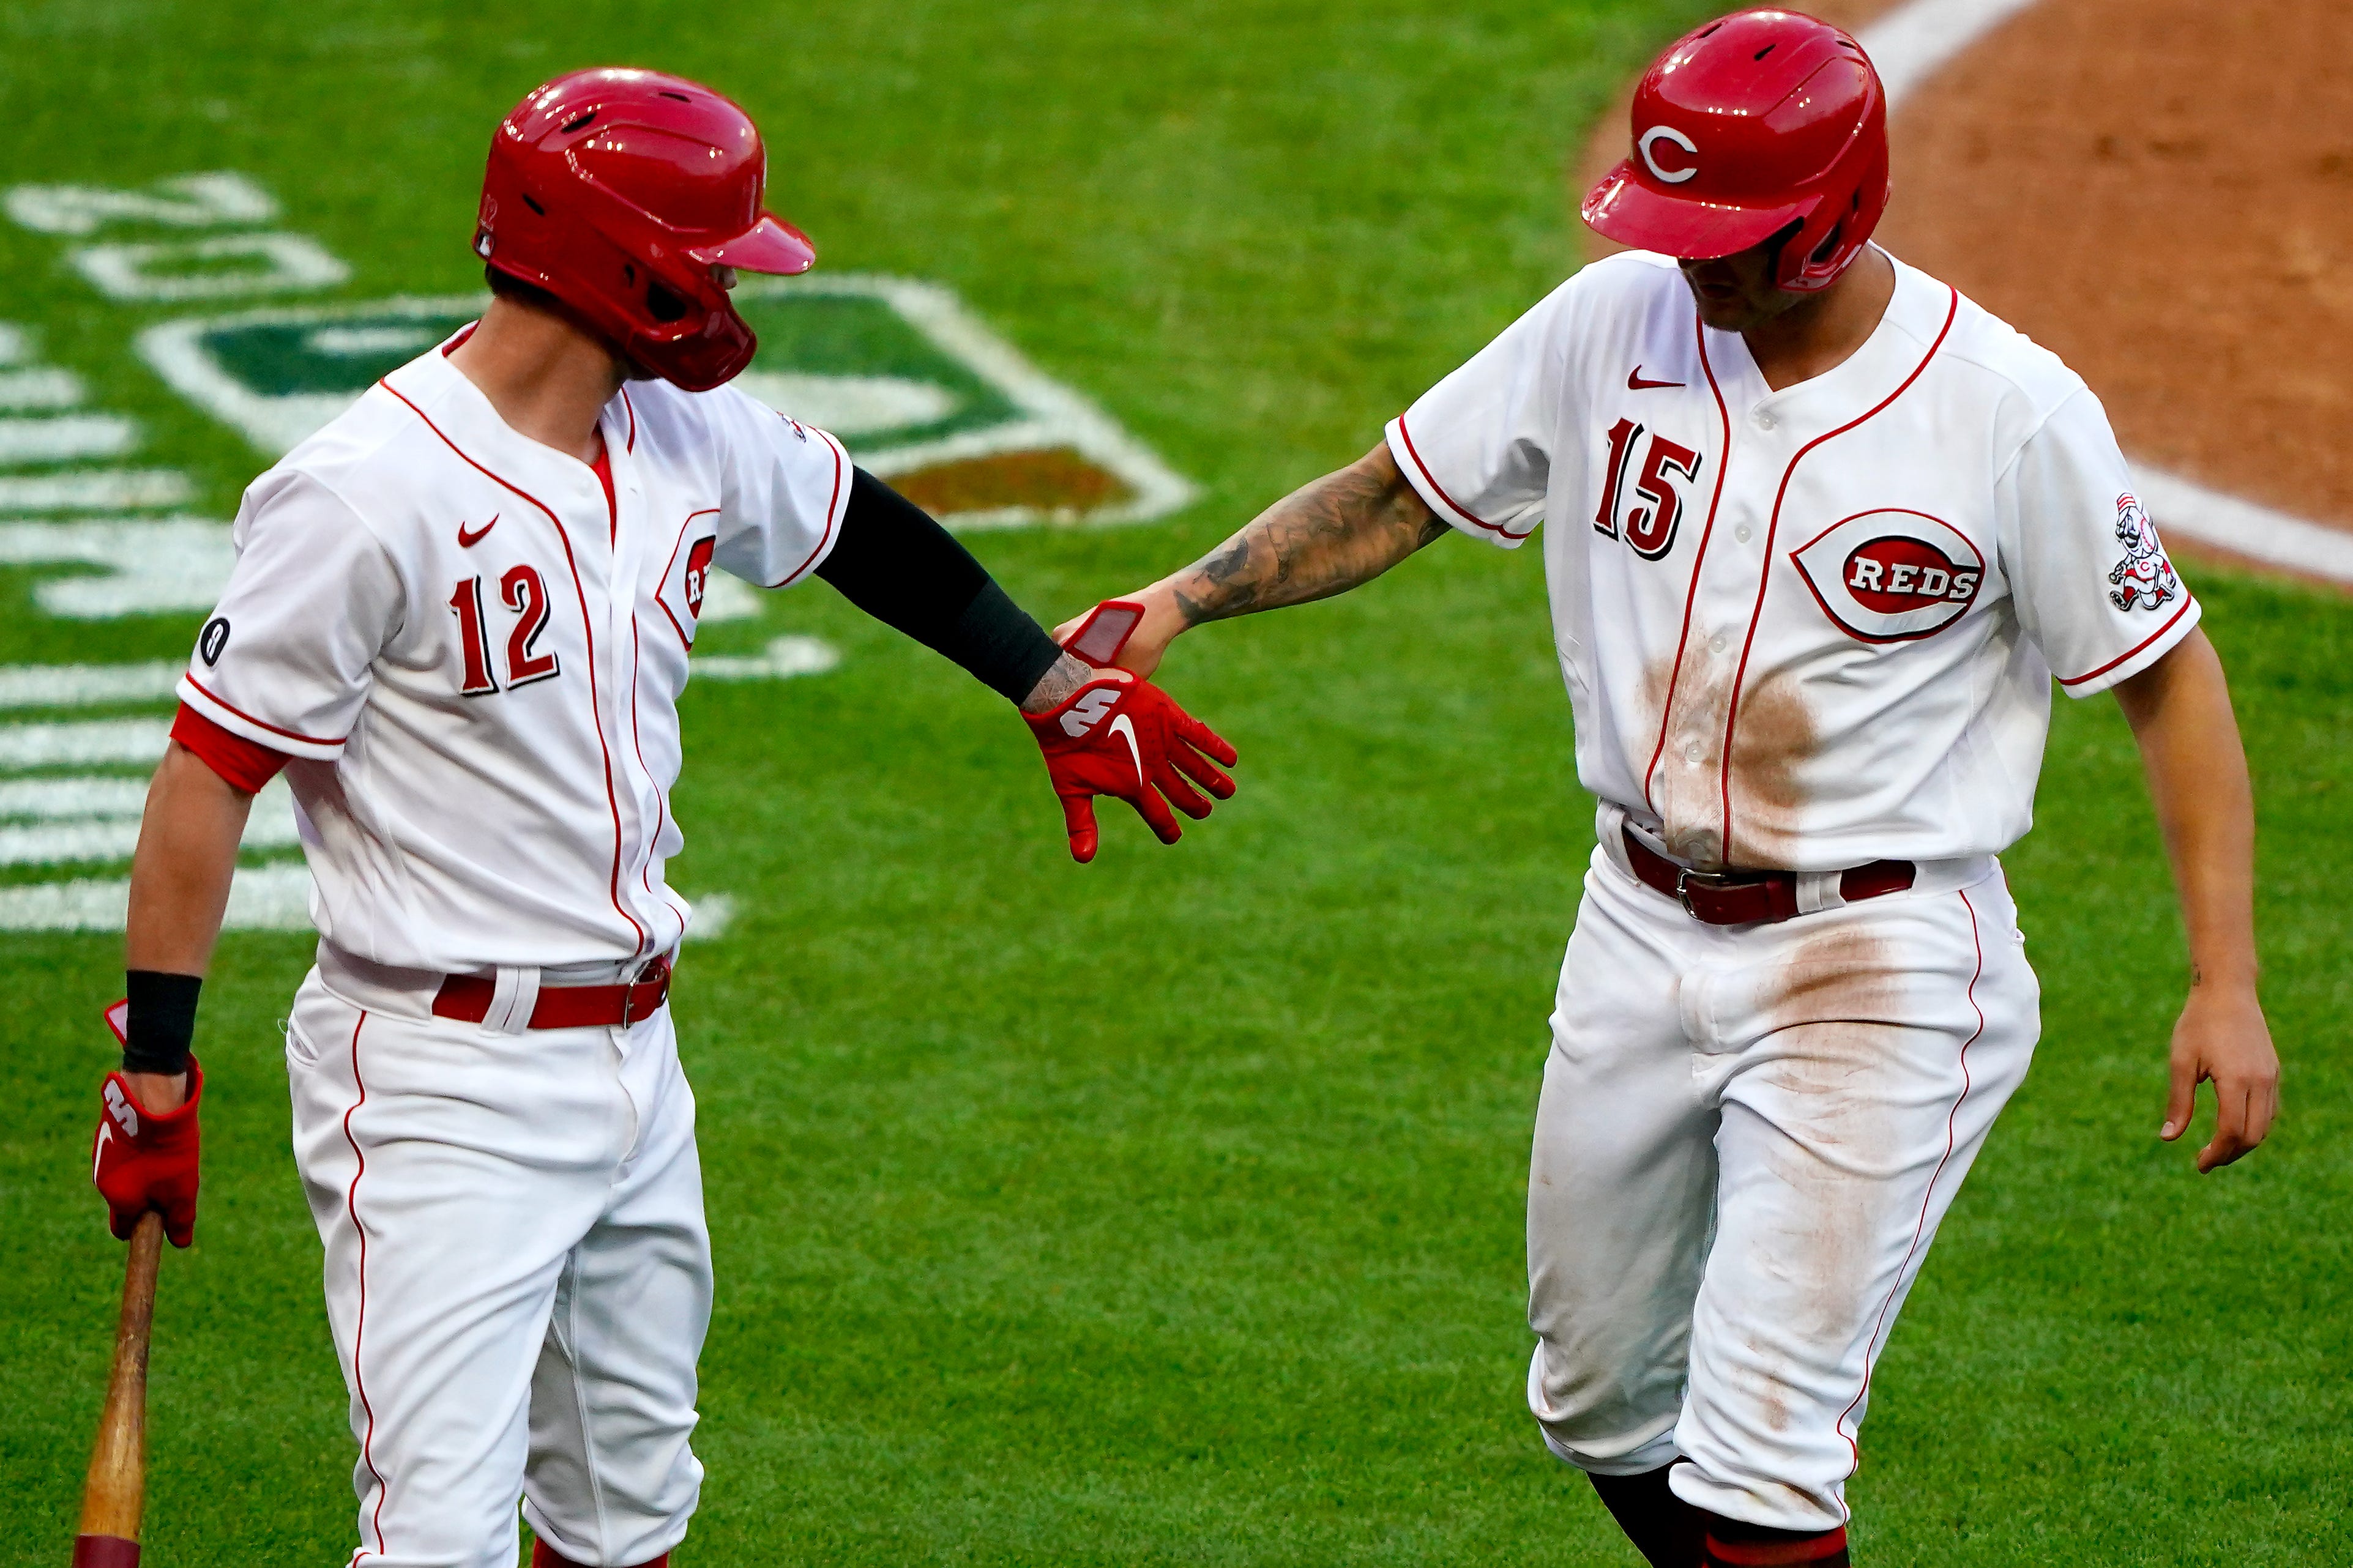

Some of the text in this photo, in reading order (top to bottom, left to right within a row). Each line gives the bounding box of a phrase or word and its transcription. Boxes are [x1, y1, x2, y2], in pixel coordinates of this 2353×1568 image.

[1638, 125, 1698, 183] C
[1592, 416, 1703, 562] 15
[1849, 555, 1979, 600] REDS
[447, 563, 561, 696] 12
